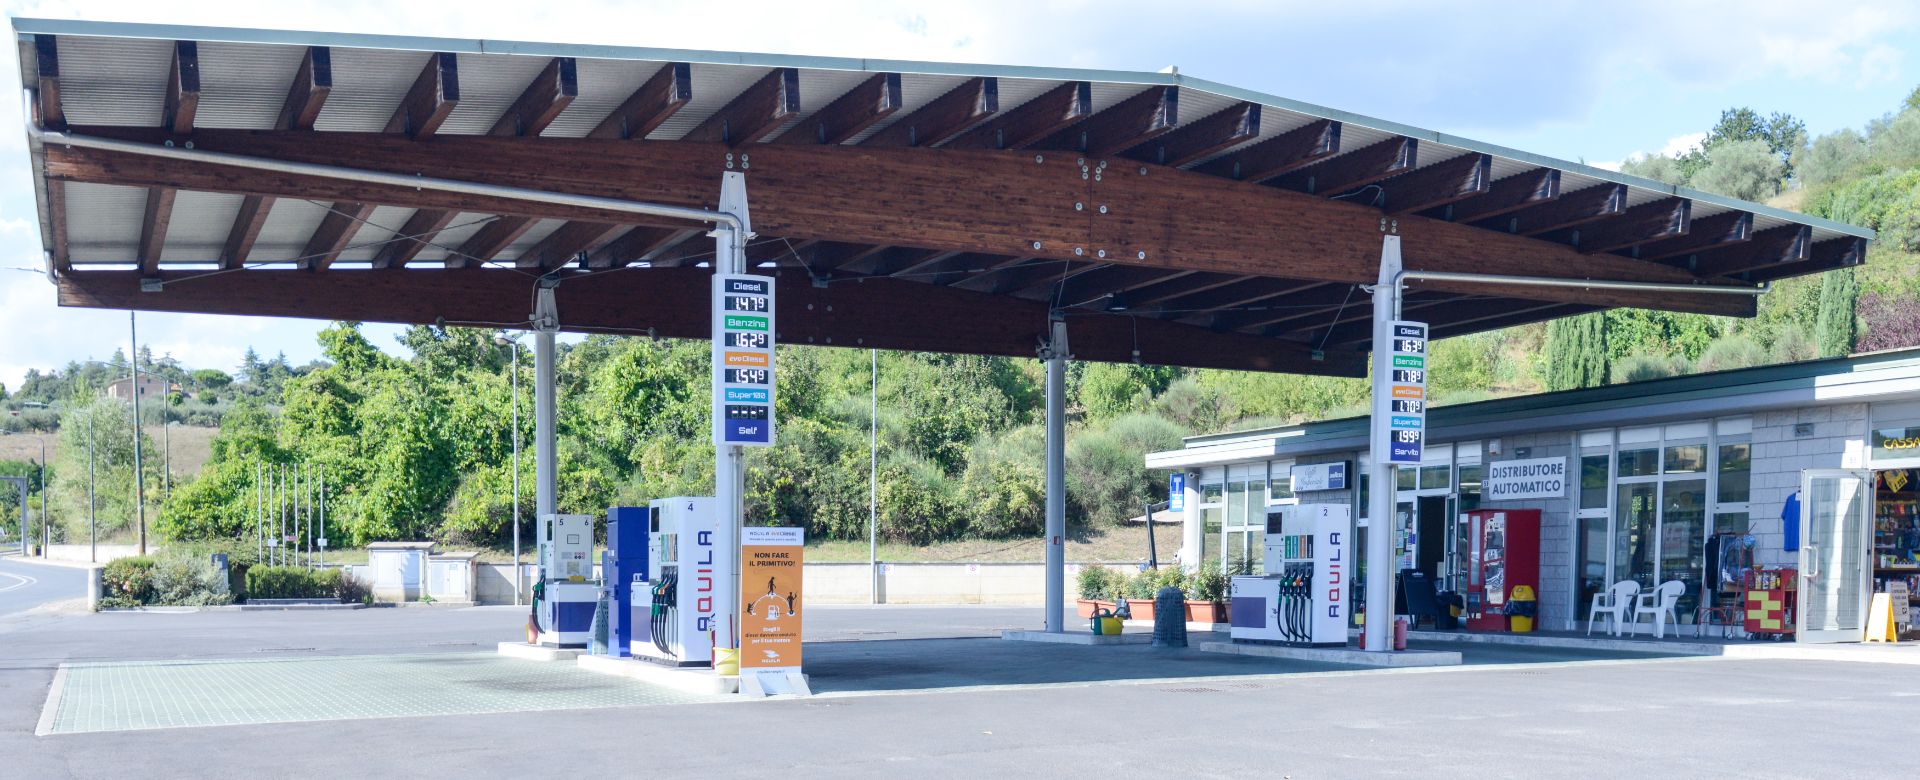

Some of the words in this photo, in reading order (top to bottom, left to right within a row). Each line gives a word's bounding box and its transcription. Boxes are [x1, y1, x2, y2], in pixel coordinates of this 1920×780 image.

[733, 282, 761, 291] Diesel
[728, 319, 766, 328] Benzina
[1395, 358, 1422, 366] Benzina
[728, 391, 766, 399] Super100
[738, 426, 758, 435] Self
[1394, 448, 1419, 456] Servito
[1492, 463, 1563, 479] DISTRIBUTORE
[1492, 480, 1561, 495] AUTOMATICO
[687, 503, 694, 512] 4
[1323, 508, 1328, 517] 2
[1328, 532, 1341, 618] AQUILA
[698, 530, 713, 631] AQUILA
